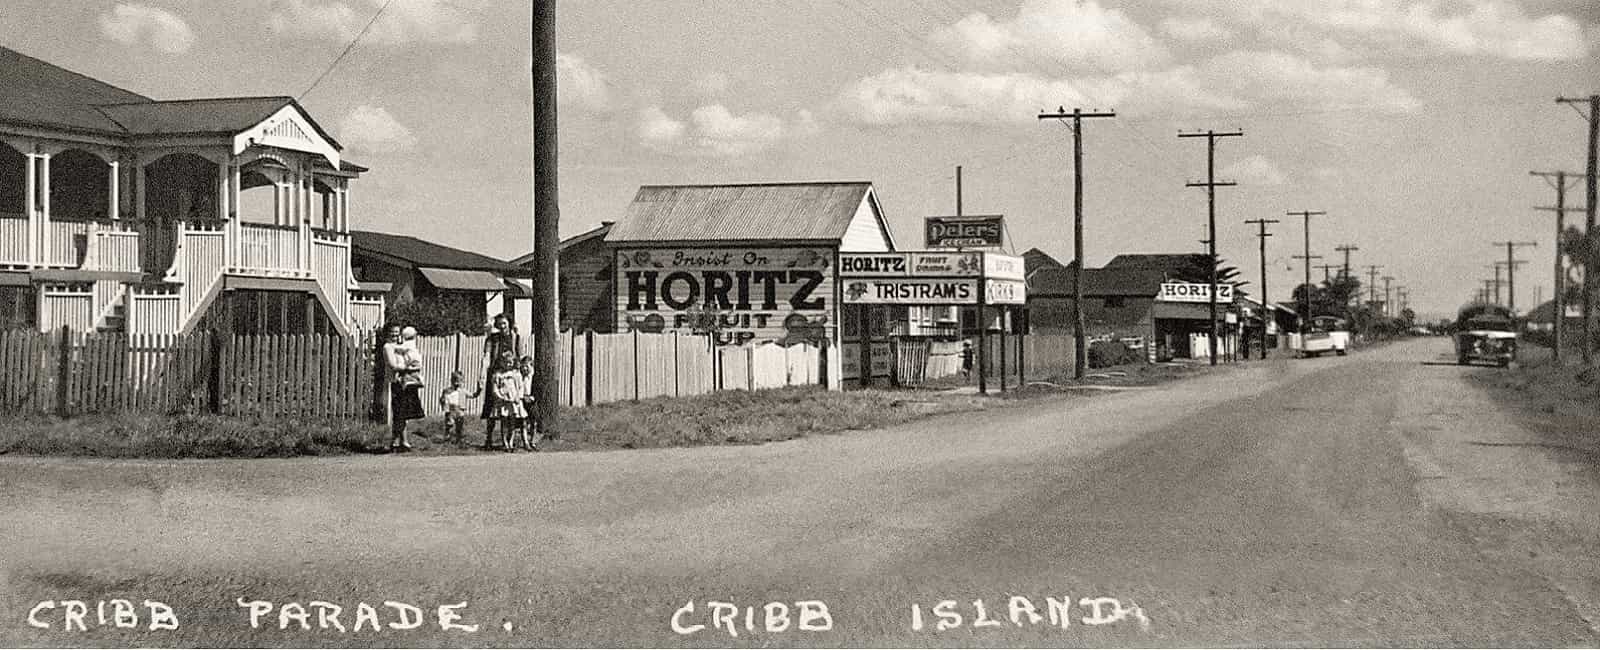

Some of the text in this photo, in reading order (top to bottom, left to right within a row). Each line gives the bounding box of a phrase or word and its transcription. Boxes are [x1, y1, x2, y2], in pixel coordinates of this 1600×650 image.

[929, 222, 999, 241] Peters
[673, 251, 769, 266] Insist On
[841, 256, 905, 272] HORITZ
[626, 270, 825, 311] HORITZ
[874, 282, 970, 299] TRISTRAM'S
[1165, 285, 1230, 297] HORIZ
